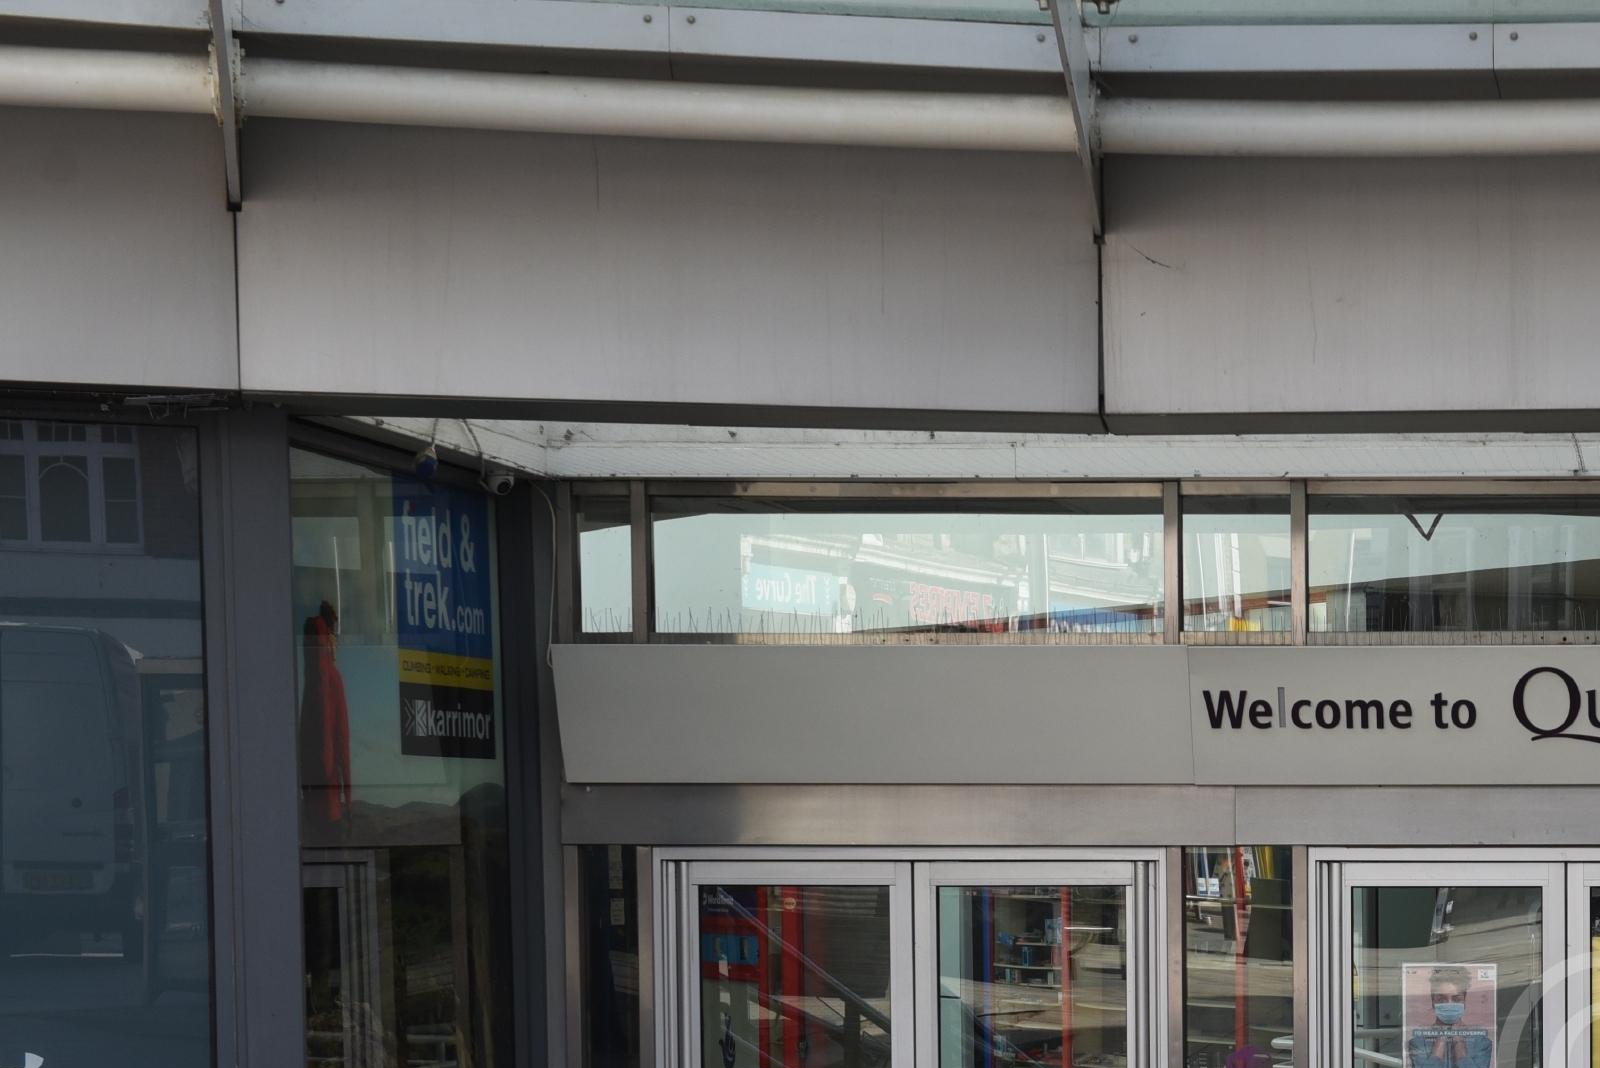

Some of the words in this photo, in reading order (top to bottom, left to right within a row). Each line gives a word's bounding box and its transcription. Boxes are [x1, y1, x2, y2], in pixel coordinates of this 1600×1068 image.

[401, 500, 452, 569] field
[460, 512, 476, 574] &
[405, 567, 485, 635] trek.com
[427, 700, 491, 740] karrimor
[1202, 685, 1412, 731] Welcome
[1431, 691, 1478, 731] to
